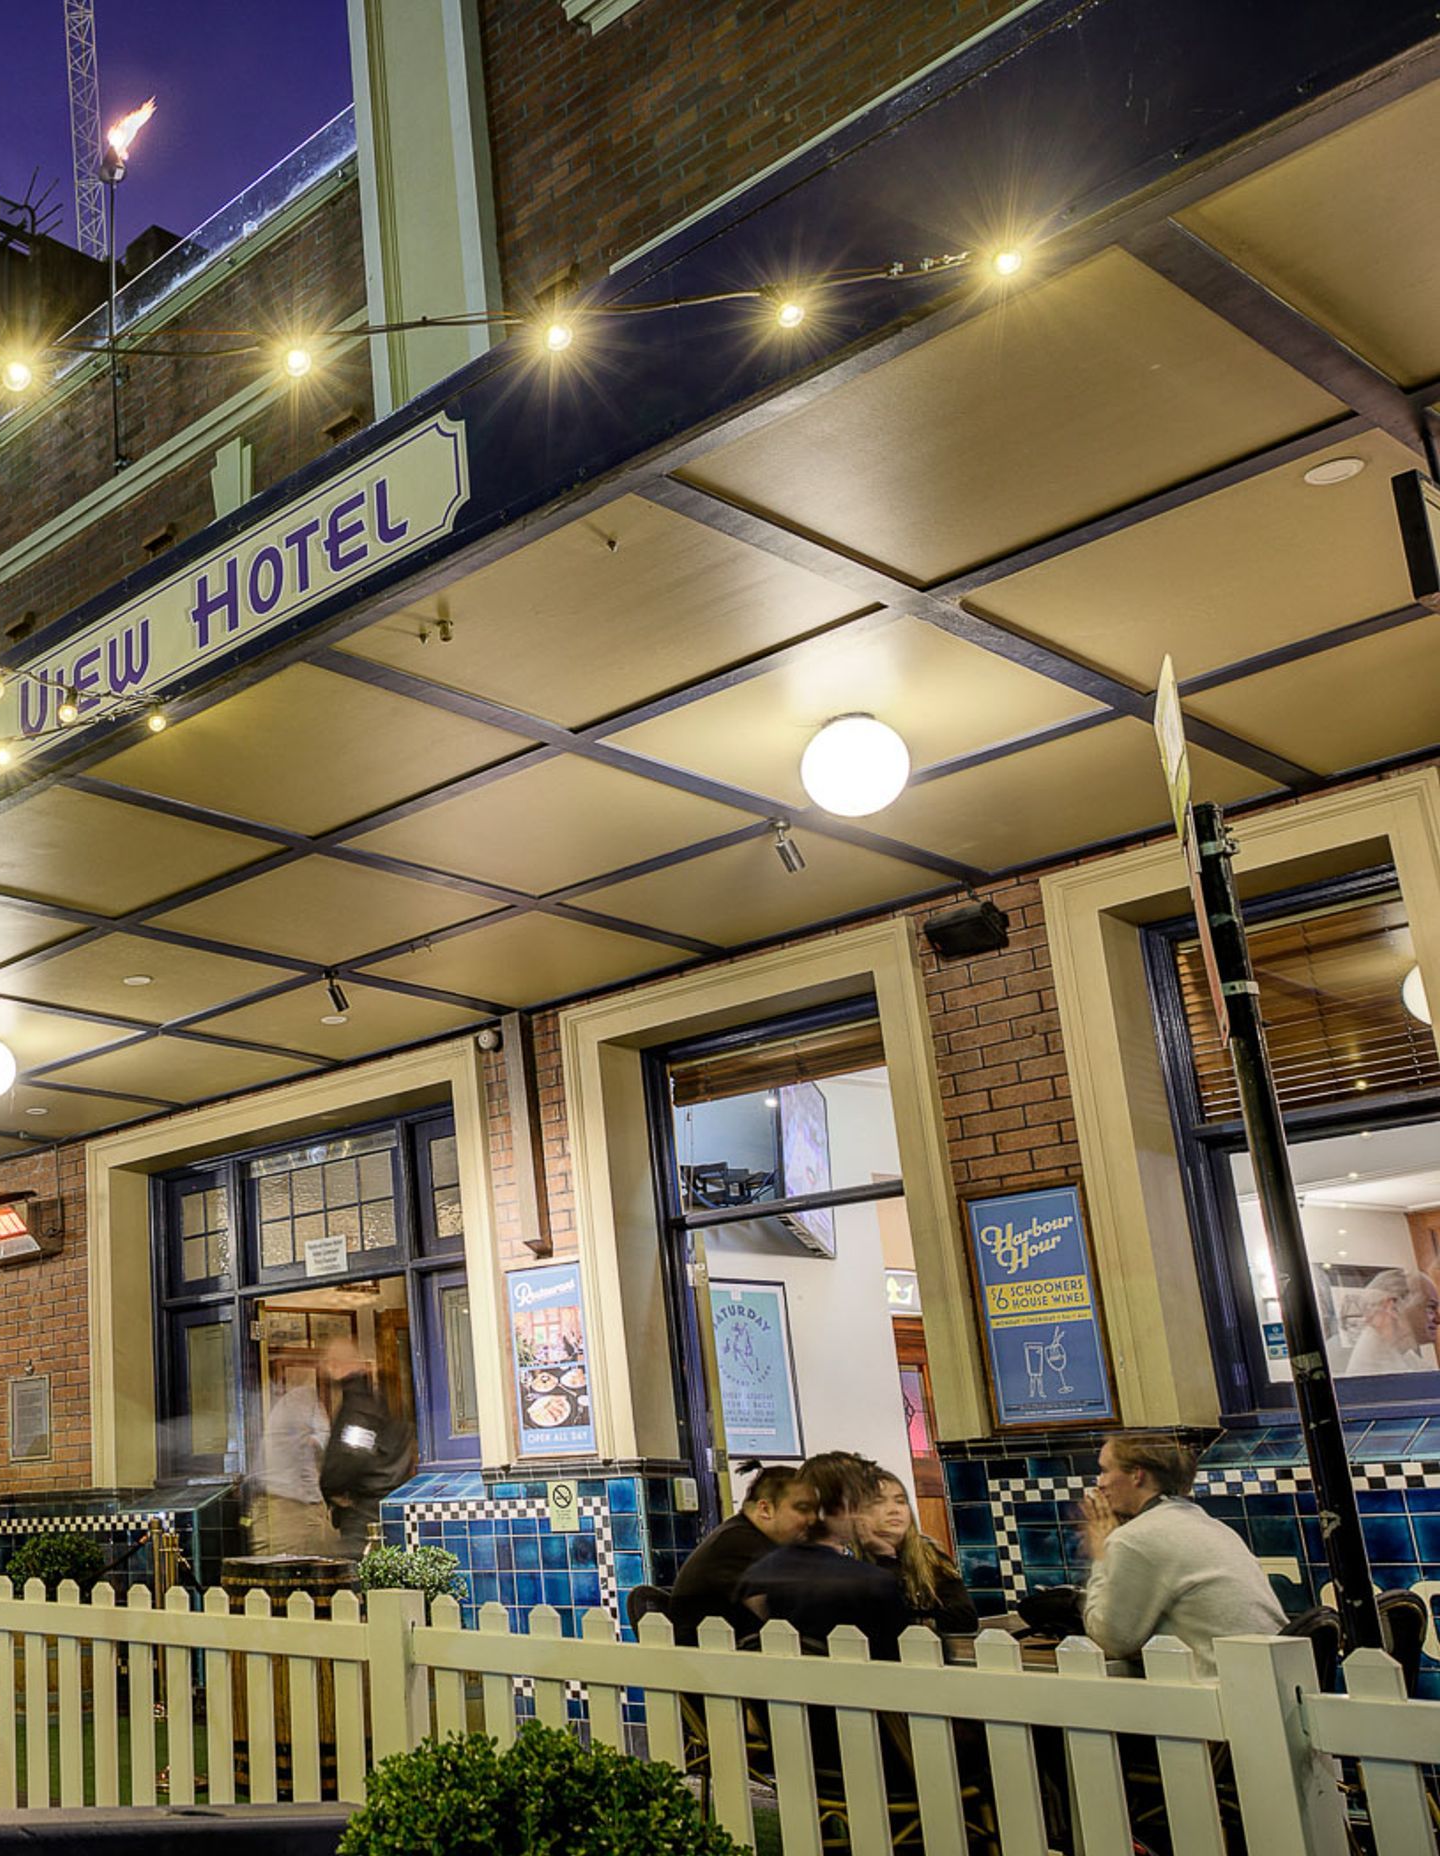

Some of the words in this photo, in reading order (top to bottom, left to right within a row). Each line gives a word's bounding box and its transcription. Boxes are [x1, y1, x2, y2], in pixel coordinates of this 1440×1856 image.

[19, 618, 151, 740] VIEW
[191, 478, 410, 648] HOTEL
[980, 1215, 1074, 1254] Harbour
[996, 1235, 1062, 1275] Hour
[990, 1287, 1009, 1310] $6
[1010, 1279, 1084, 1297] SCHOONERS
[1012, 1295, 1049, 1309] HOUSE
[1051, 1291, 1086, 1304] WINES
[527, 1433, 552, 1444] OPEN
[570, 1430, 588, 1441] DAY
